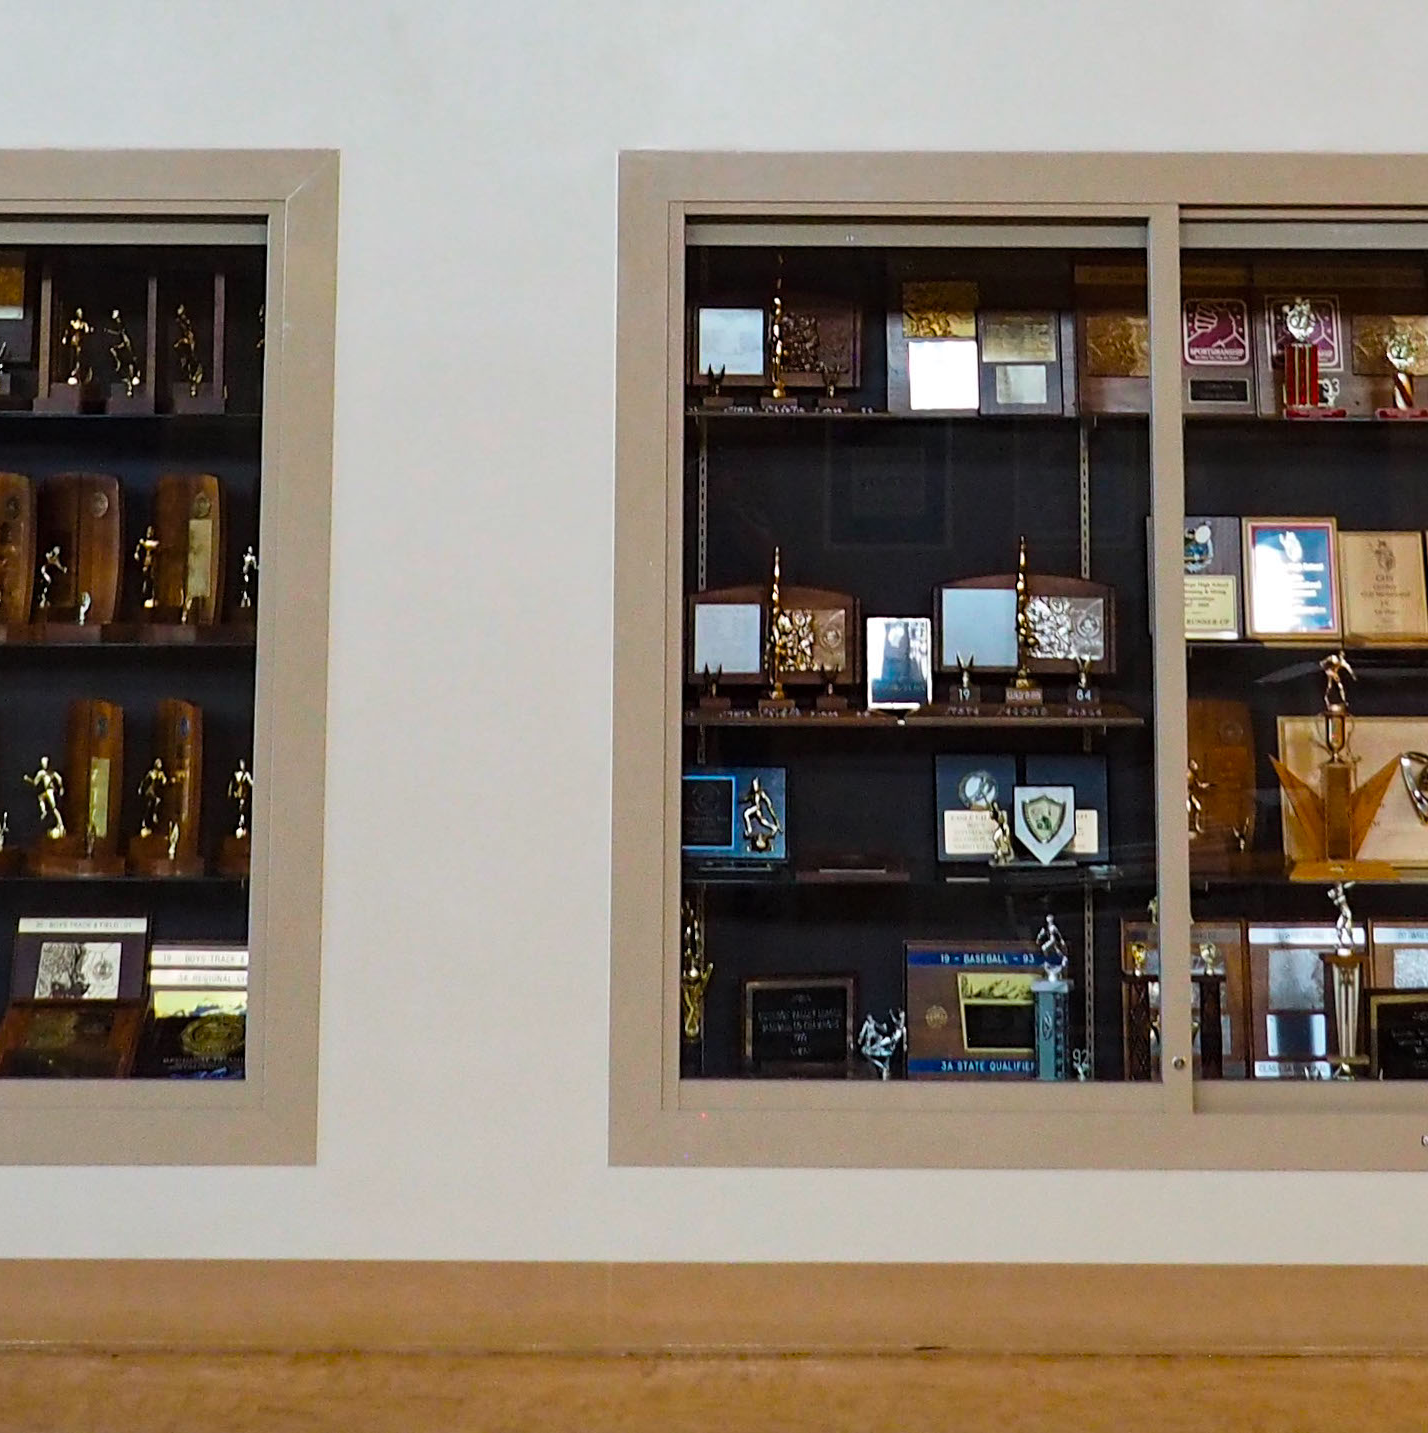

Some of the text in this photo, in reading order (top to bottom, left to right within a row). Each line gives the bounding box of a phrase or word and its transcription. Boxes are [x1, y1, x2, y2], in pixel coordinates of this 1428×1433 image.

[958, 688, 971, 702] 19
[940, 953, 951, 964] 19
[963, 953, 1009, 964] BASEBALL
[1022, 953, 1035, 964] 93
[941, 1061, 953, 1072] 3A
[958, 1061, 984, 1072] STATE
